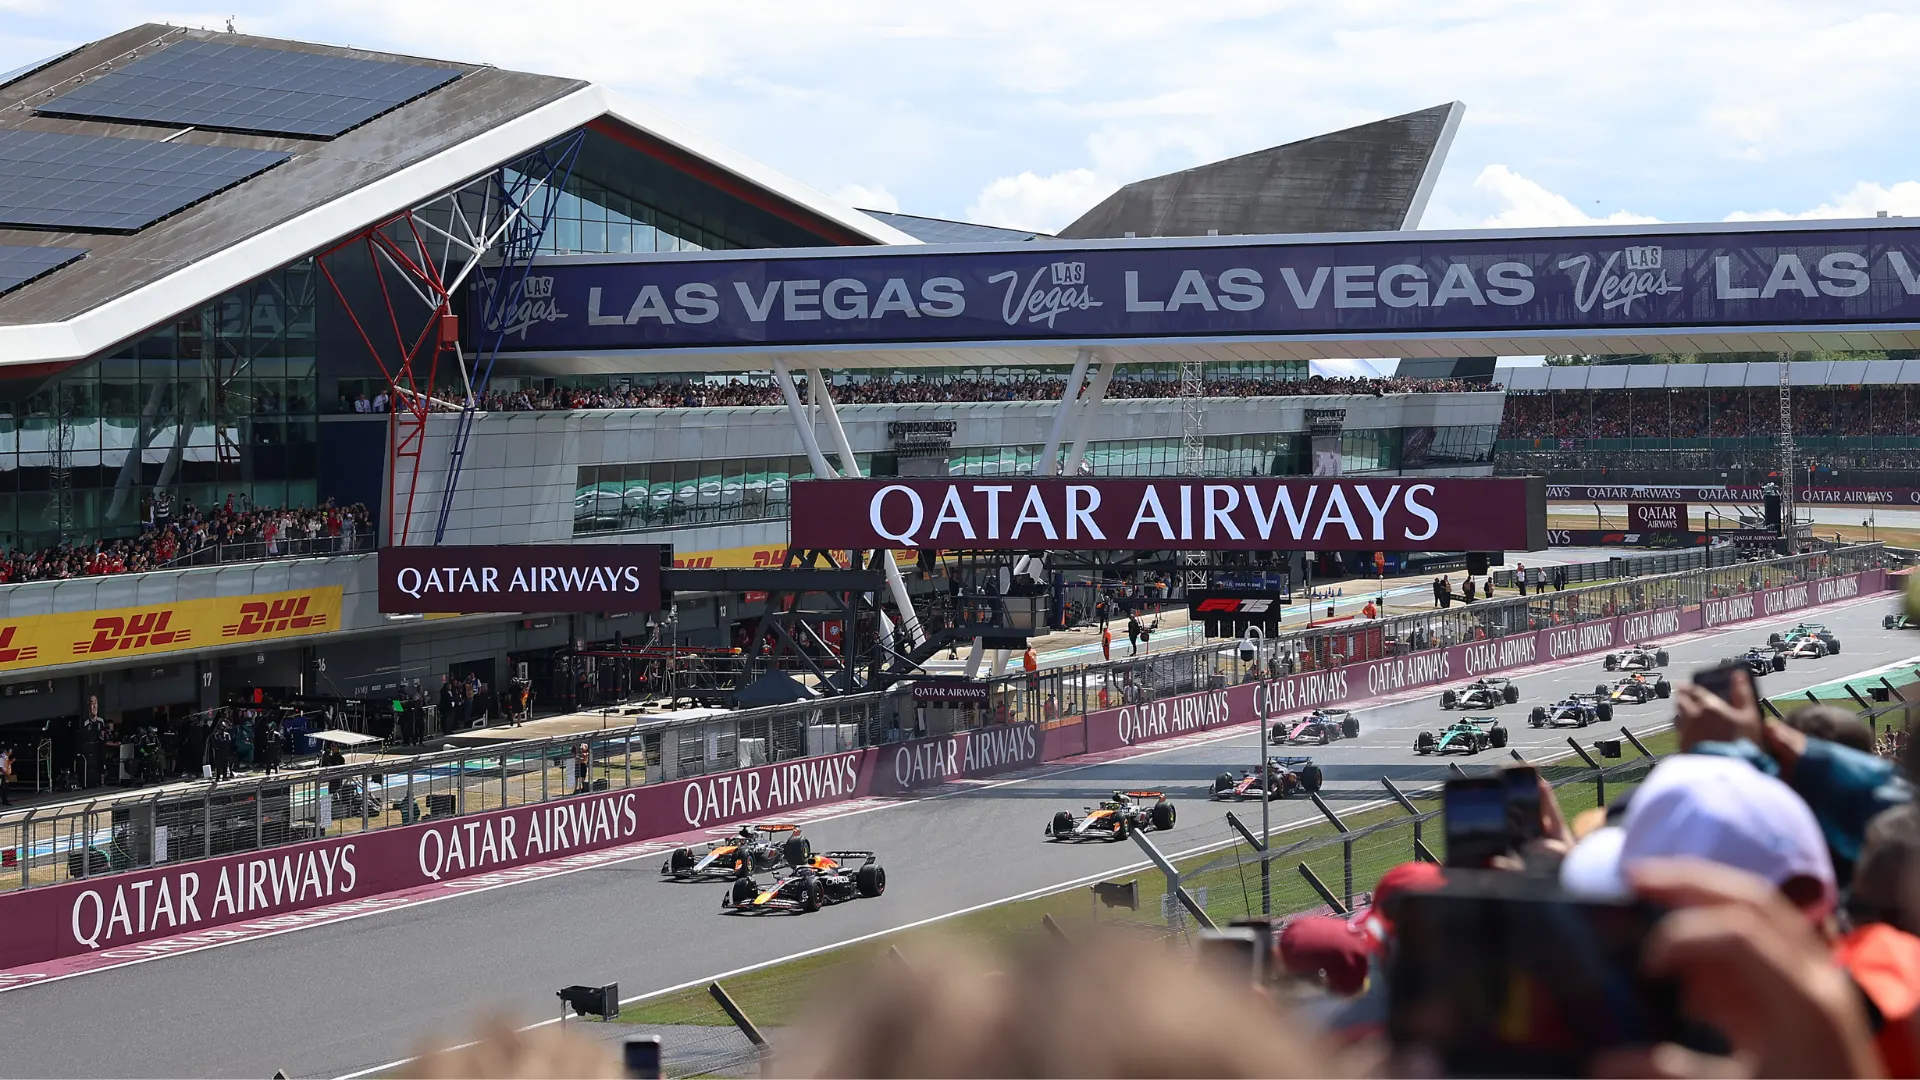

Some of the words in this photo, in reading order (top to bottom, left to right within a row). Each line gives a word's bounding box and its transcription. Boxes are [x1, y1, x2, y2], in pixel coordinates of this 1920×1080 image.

[1054, 263, 1083, 284] LAS
[1627, 247, 1661, 269] LAS
[1716, 252, 1870, 300] LAS
[525, 278, 552, 296] LAS
[588, 283, 719, 326] LAS
[733, 276, 965, 322] VEGAS
[988, 266, 1103, 329] Vegas
[1124, 267, 1265, 313] LAS
[1279, 261, 1535, 309] VEGAS
[1558, 250, 1683, 316] Vegas
[1587, 487, 1627, 499] QATAR
[1630, 487, 1681, 499] AIRWAYS
[1698, 488, 1738, 501] QATAR
[1802, 490, 1840, 502] QATAR
[869, 485, 1107, 546] QATAR
[1127, 484, 1439, 541] AIRWAYS
[1638, 506, 1677, 521] QATAR
[1648, 521, 1678, 529] AIRWAYS
[397, 567, 500, 599] QATAR
[508, 566, 640, 592] AIRWAYS
[236, 596, 315, 636] DHL
[720, 605, 727, 617] 13
[1623, 616, 1648, 644] QATAR
[1650, 608, 1679, 635] AIRWAYS
[88, 610, 177, 655] DHL
[1549, 630, 1578, 660] QATAR
[1579, 622, 1612, 651] AIRWAYS
[1368, 661, 1405, 695] QATAR
[1407, 651, 1450, 686] AIRWAYS
[1465, 644, 1498, 676] QATAR
[1499, 636, 1536, 667] AIRWAYS
[203, 672, 212, 687] 17
[914, 687, 945, 697] QATAR
[947, 688, 986, 697] AIRWAYS
[1298, 669, 1348, 708] AIRWAYS
[1118, 702, 1167, 745] QATAR
[1172, 690, 1230, 732] AIRWAYS
[895, 738, 959, 788] QATAR
[962, 724, 1036, 771] AIRWAYS
[683, 775, 761, 828] QATAR
[767, 754, 857, 810] AIRWAYS
[418, 815, 518, 881] QATAR
[525, 793, 637, 856] AIRWAYS
[72, 871, 201, 949] QATAR
[211, 844, 357, 918] AIRWAYS
